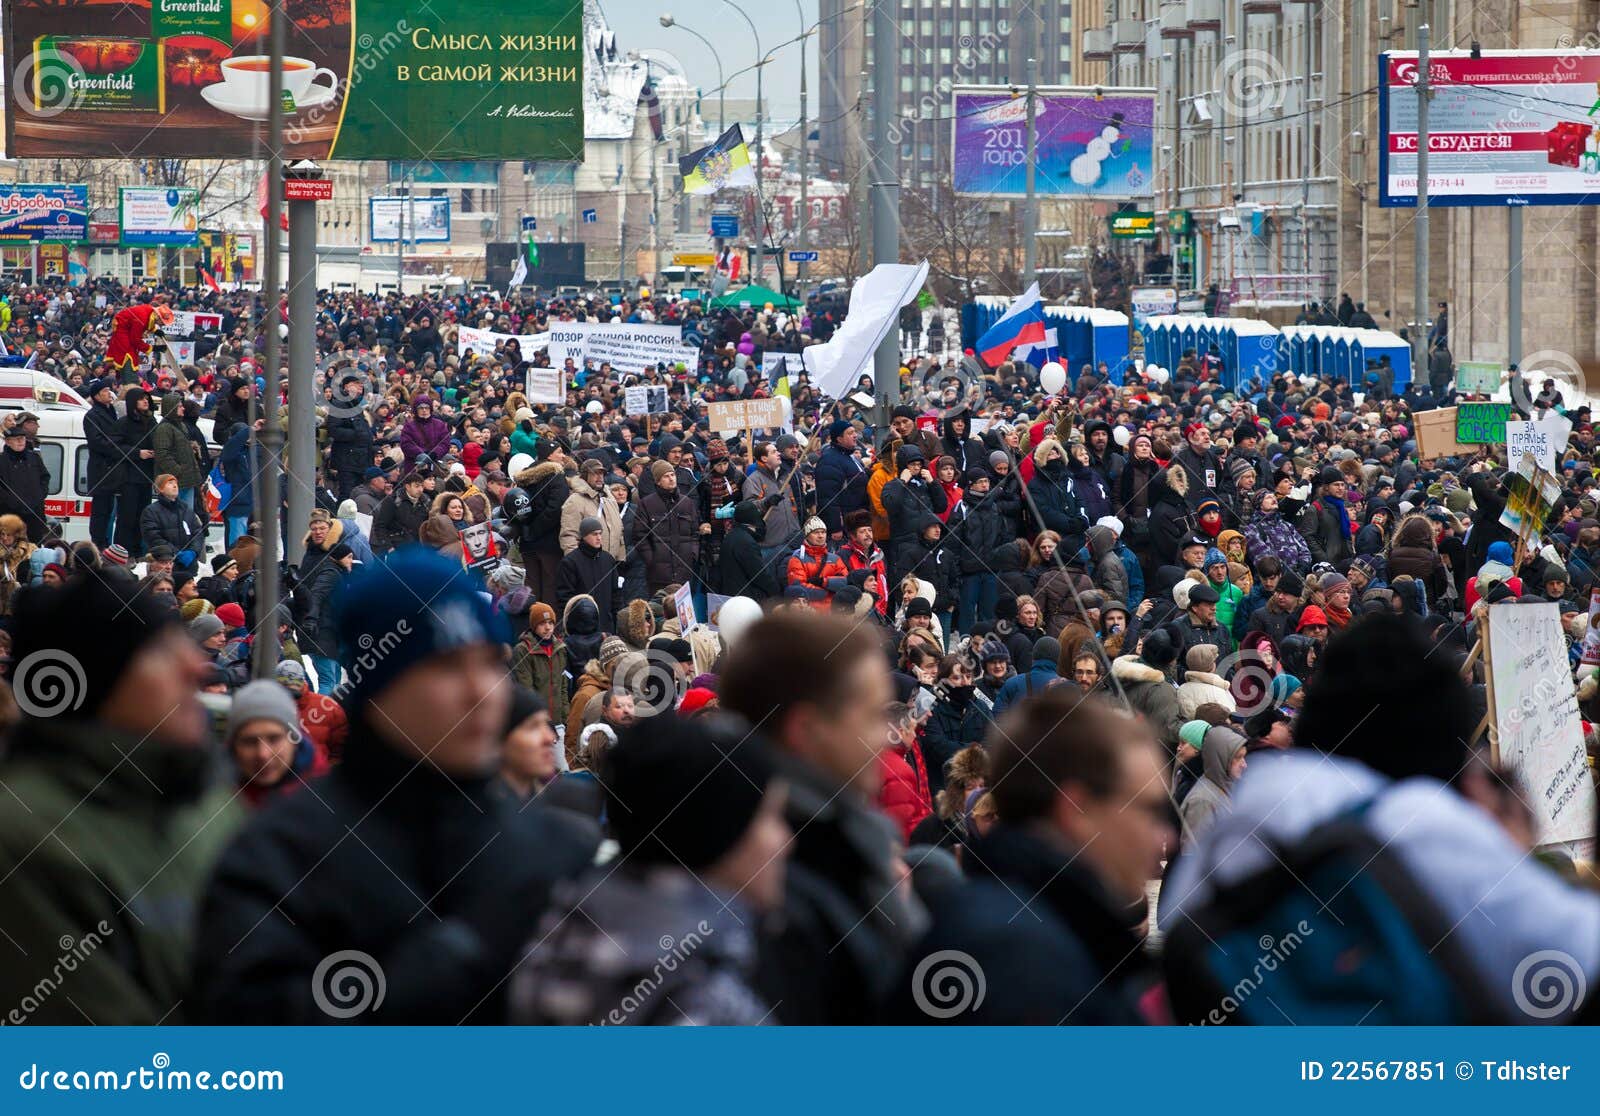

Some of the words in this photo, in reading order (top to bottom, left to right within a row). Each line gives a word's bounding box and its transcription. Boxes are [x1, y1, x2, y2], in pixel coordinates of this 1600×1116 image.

[412, 27, 493, 50] Смысл
[500, 34, 577, 51] жизни
[397, 65, 410, 81] в
[418, 63, 492, 81] самой
[500, 66, 577, 82] жизни
[67, 73, 134, 90] Greenfield
[1396, 136, 1418, 149] ВС
[1428, 135, 1513, 152] СБУДЕТСЯ!
[1427, 178, 1465, 187] 71-74-44
[0, 193, 64, 214] убровка
[551, 332, 584, 343] ПОЗОР
[715, 405, 728, 416] ЗА
[1524, 422, 1535, 434] ЗА
[1512, 433, 1547, 446] ПРЯМЫЕ
[1511, 445, 1548, 457] ВЫБОРЫ
